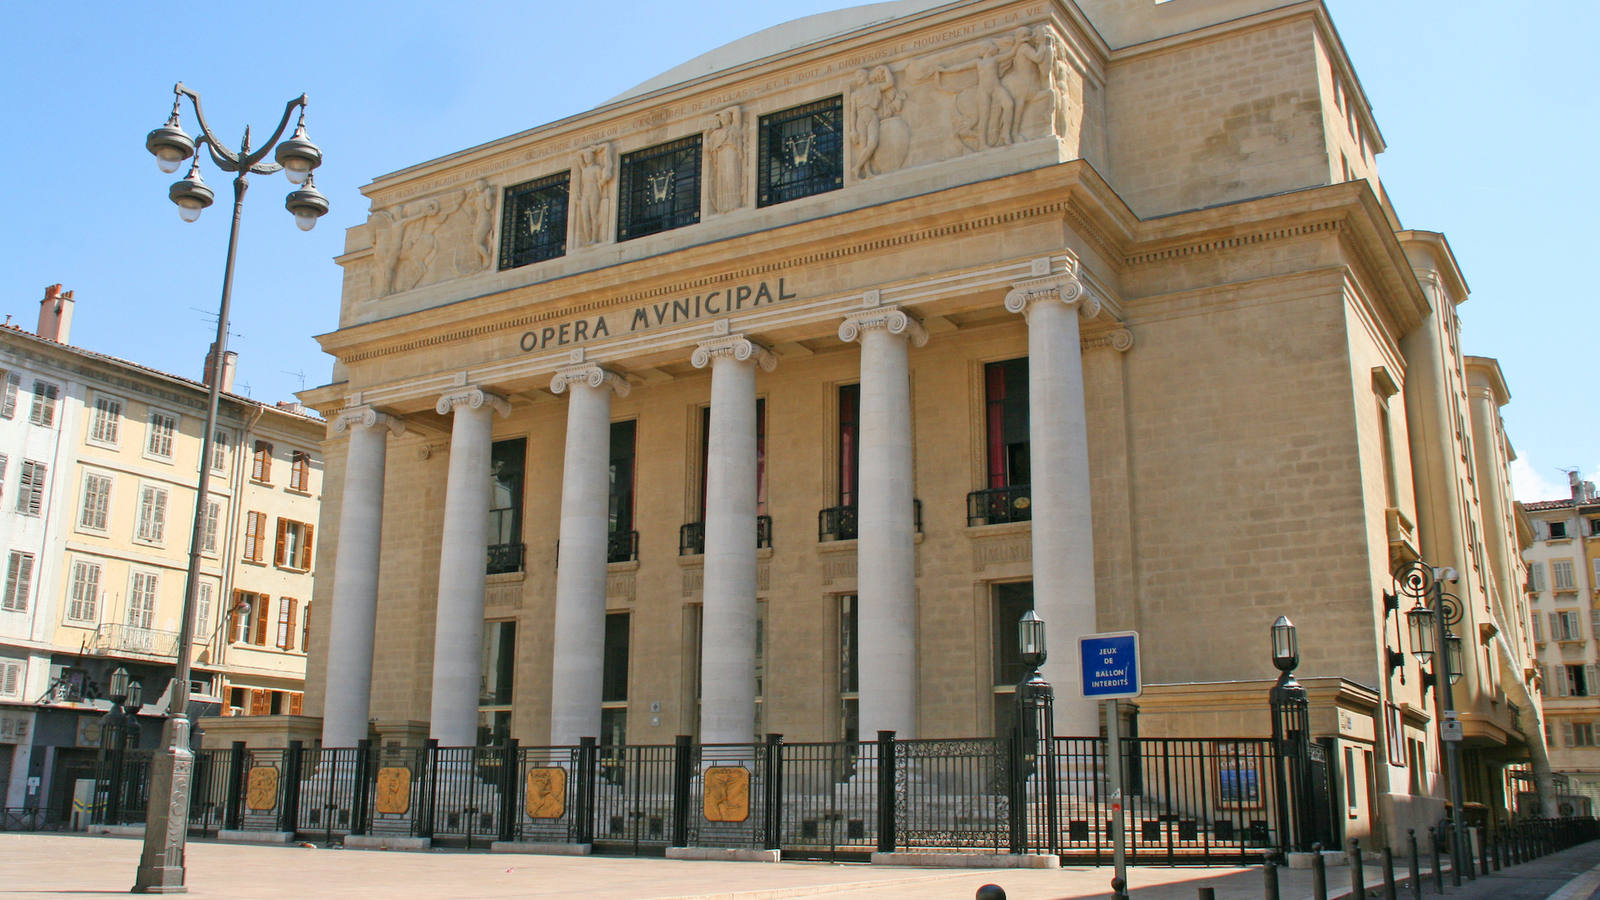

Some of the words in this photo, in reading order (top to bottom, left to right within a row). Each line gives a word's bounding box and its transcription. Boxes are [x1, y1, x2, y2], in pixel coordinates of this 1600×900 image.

[538, 140, 571, 157] RYTHME
[574, 127, 618, 146] D'APOLLON
[632, 106, 687, 129] L'EQUILIBRE
[692, 101, 704, 111] DE
[710, 89, 749, 107] PALLAS
[766, 80, 778, 91] ET
[783, 77, 792, 86] IL
[798, 68, 820, 81] DOIT
[825, 64, 833, 74] A
[838, 49, 888, 70] DIONYSOS
[894, 44, 907, 54] LE
[913, 23, 977, 49] MOUVEMENT
[984, 18, 998, 29] ET
[1004, 12, 1019, 23] LA
[1026, 6, 1044, 17] VIE
[519, 316, 609, 352] OPERA
[630, 277, 797, 331] MVNICIPAL
[1099, 647, 1117, 655] JEUX
[1095, 669, 1124, 677] BALLON
[1091, 679, 1128, 688] INTERDITS
